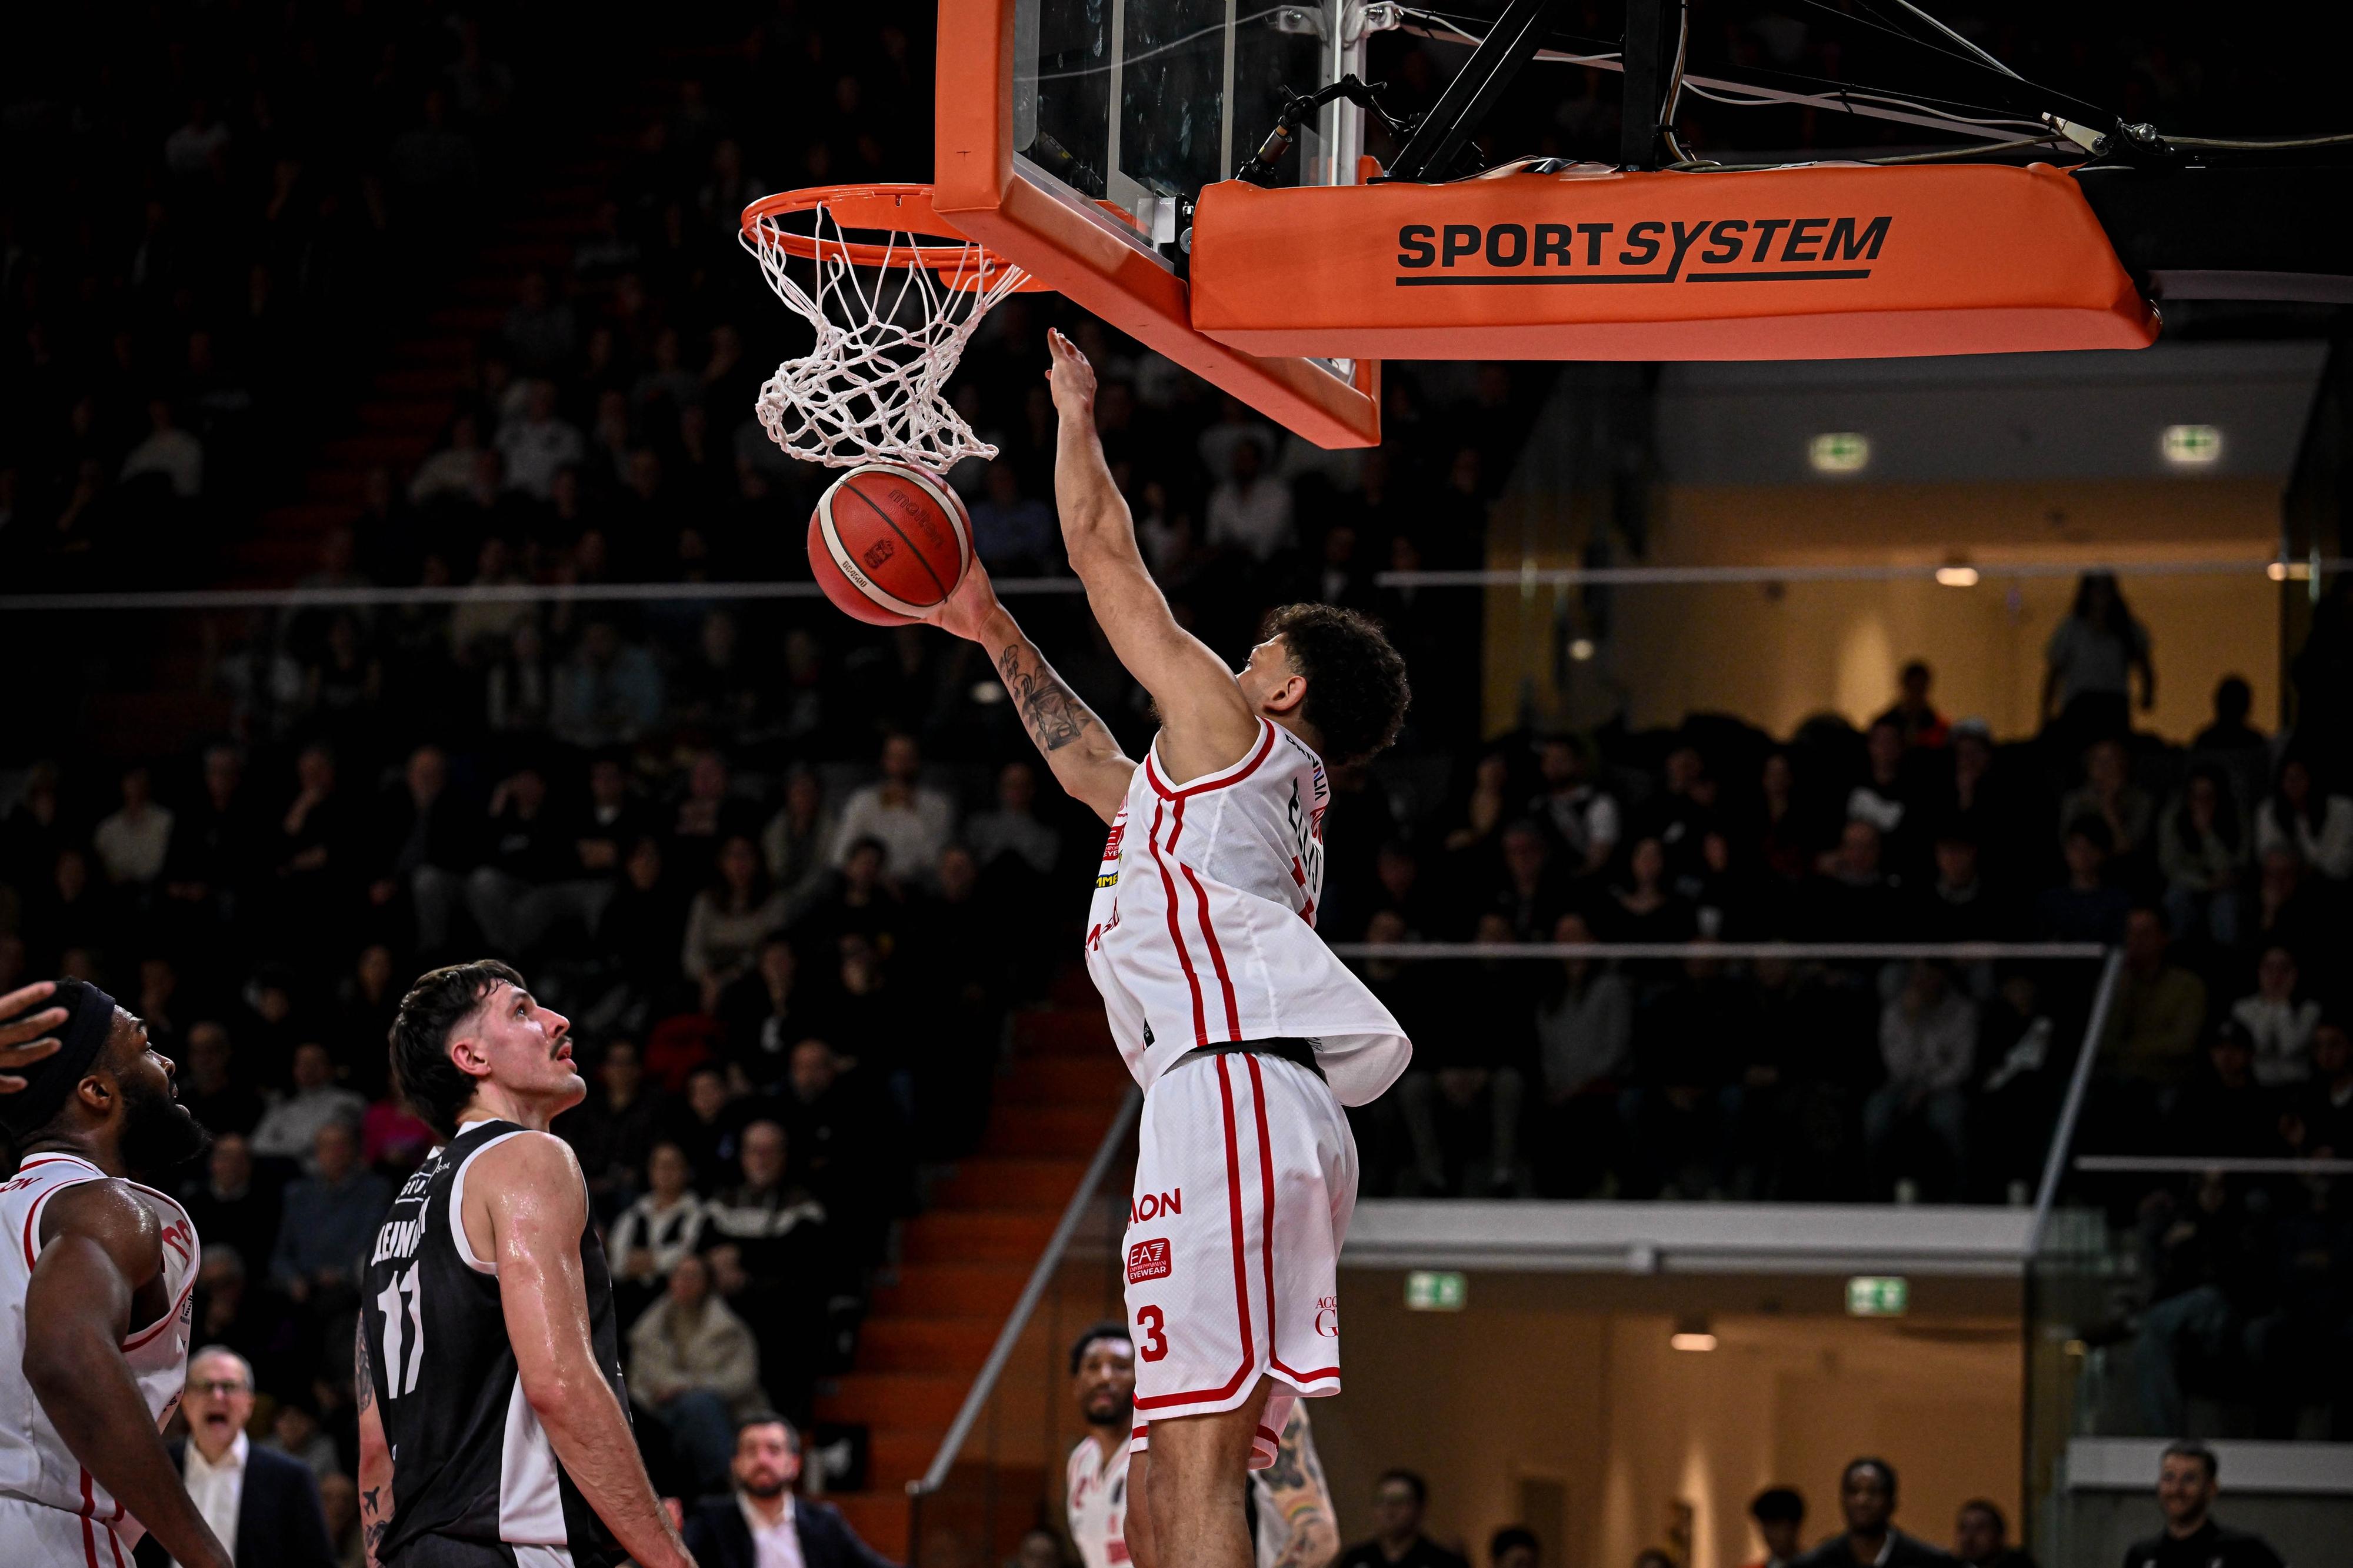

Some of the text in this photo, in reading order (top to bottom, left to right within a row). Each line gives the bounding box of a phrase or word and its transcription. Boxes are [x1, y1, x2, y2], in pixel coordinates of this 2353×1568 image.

[1397, 215, 1892, 282] SPORT SYSTEM
[0, 1177, 44, 1193] ON
[1129, 1242, 1165, 1267] EA7
[1130, 1266, 1166, 1280] EYEWEAR
[1136, 1304, 1169, 1363] 3
